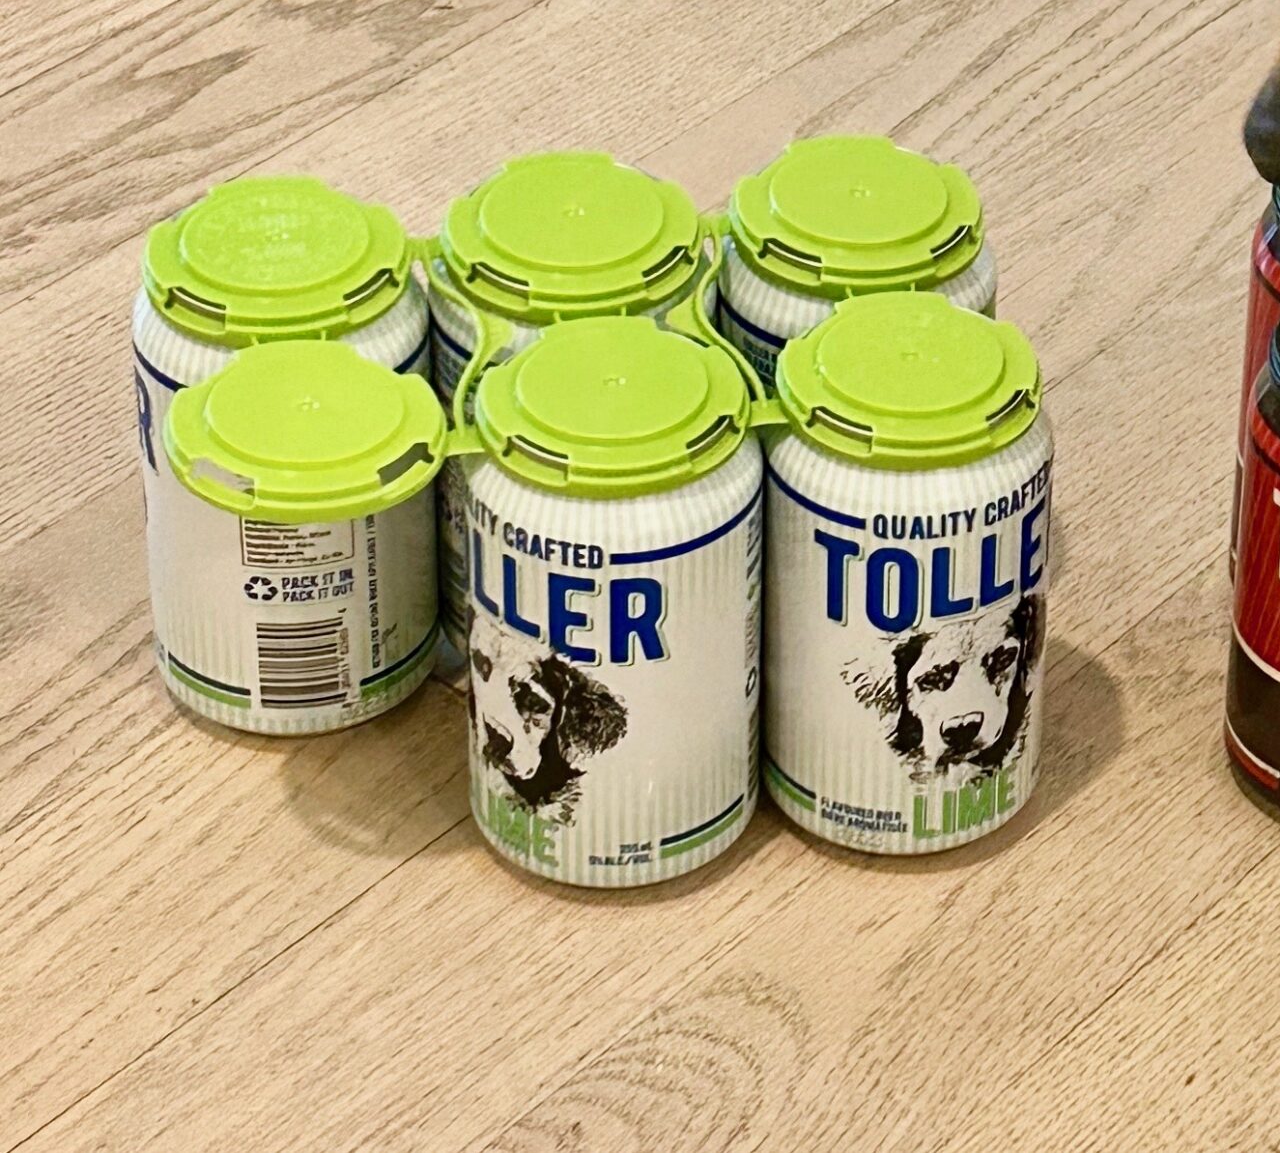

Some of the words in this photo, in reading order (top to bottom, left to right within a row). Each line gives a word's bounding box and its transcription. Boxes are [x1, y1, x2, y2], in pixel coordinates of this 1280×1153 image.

[873, 507, 976, 540] QUALITY
[984, 460, 1051, 526] CRAFTE
[281, 575, 319, 590] PACK
[503, 521, 604, 569] CRAFTED
[814, 497, 1049, 633] TOLLE
[283, 590, 316, 602] PACK
[332, 581, 354, 597] OUT
[473, 529, 668, 665] LLER
[912, 763, 1017, 839] LIME
